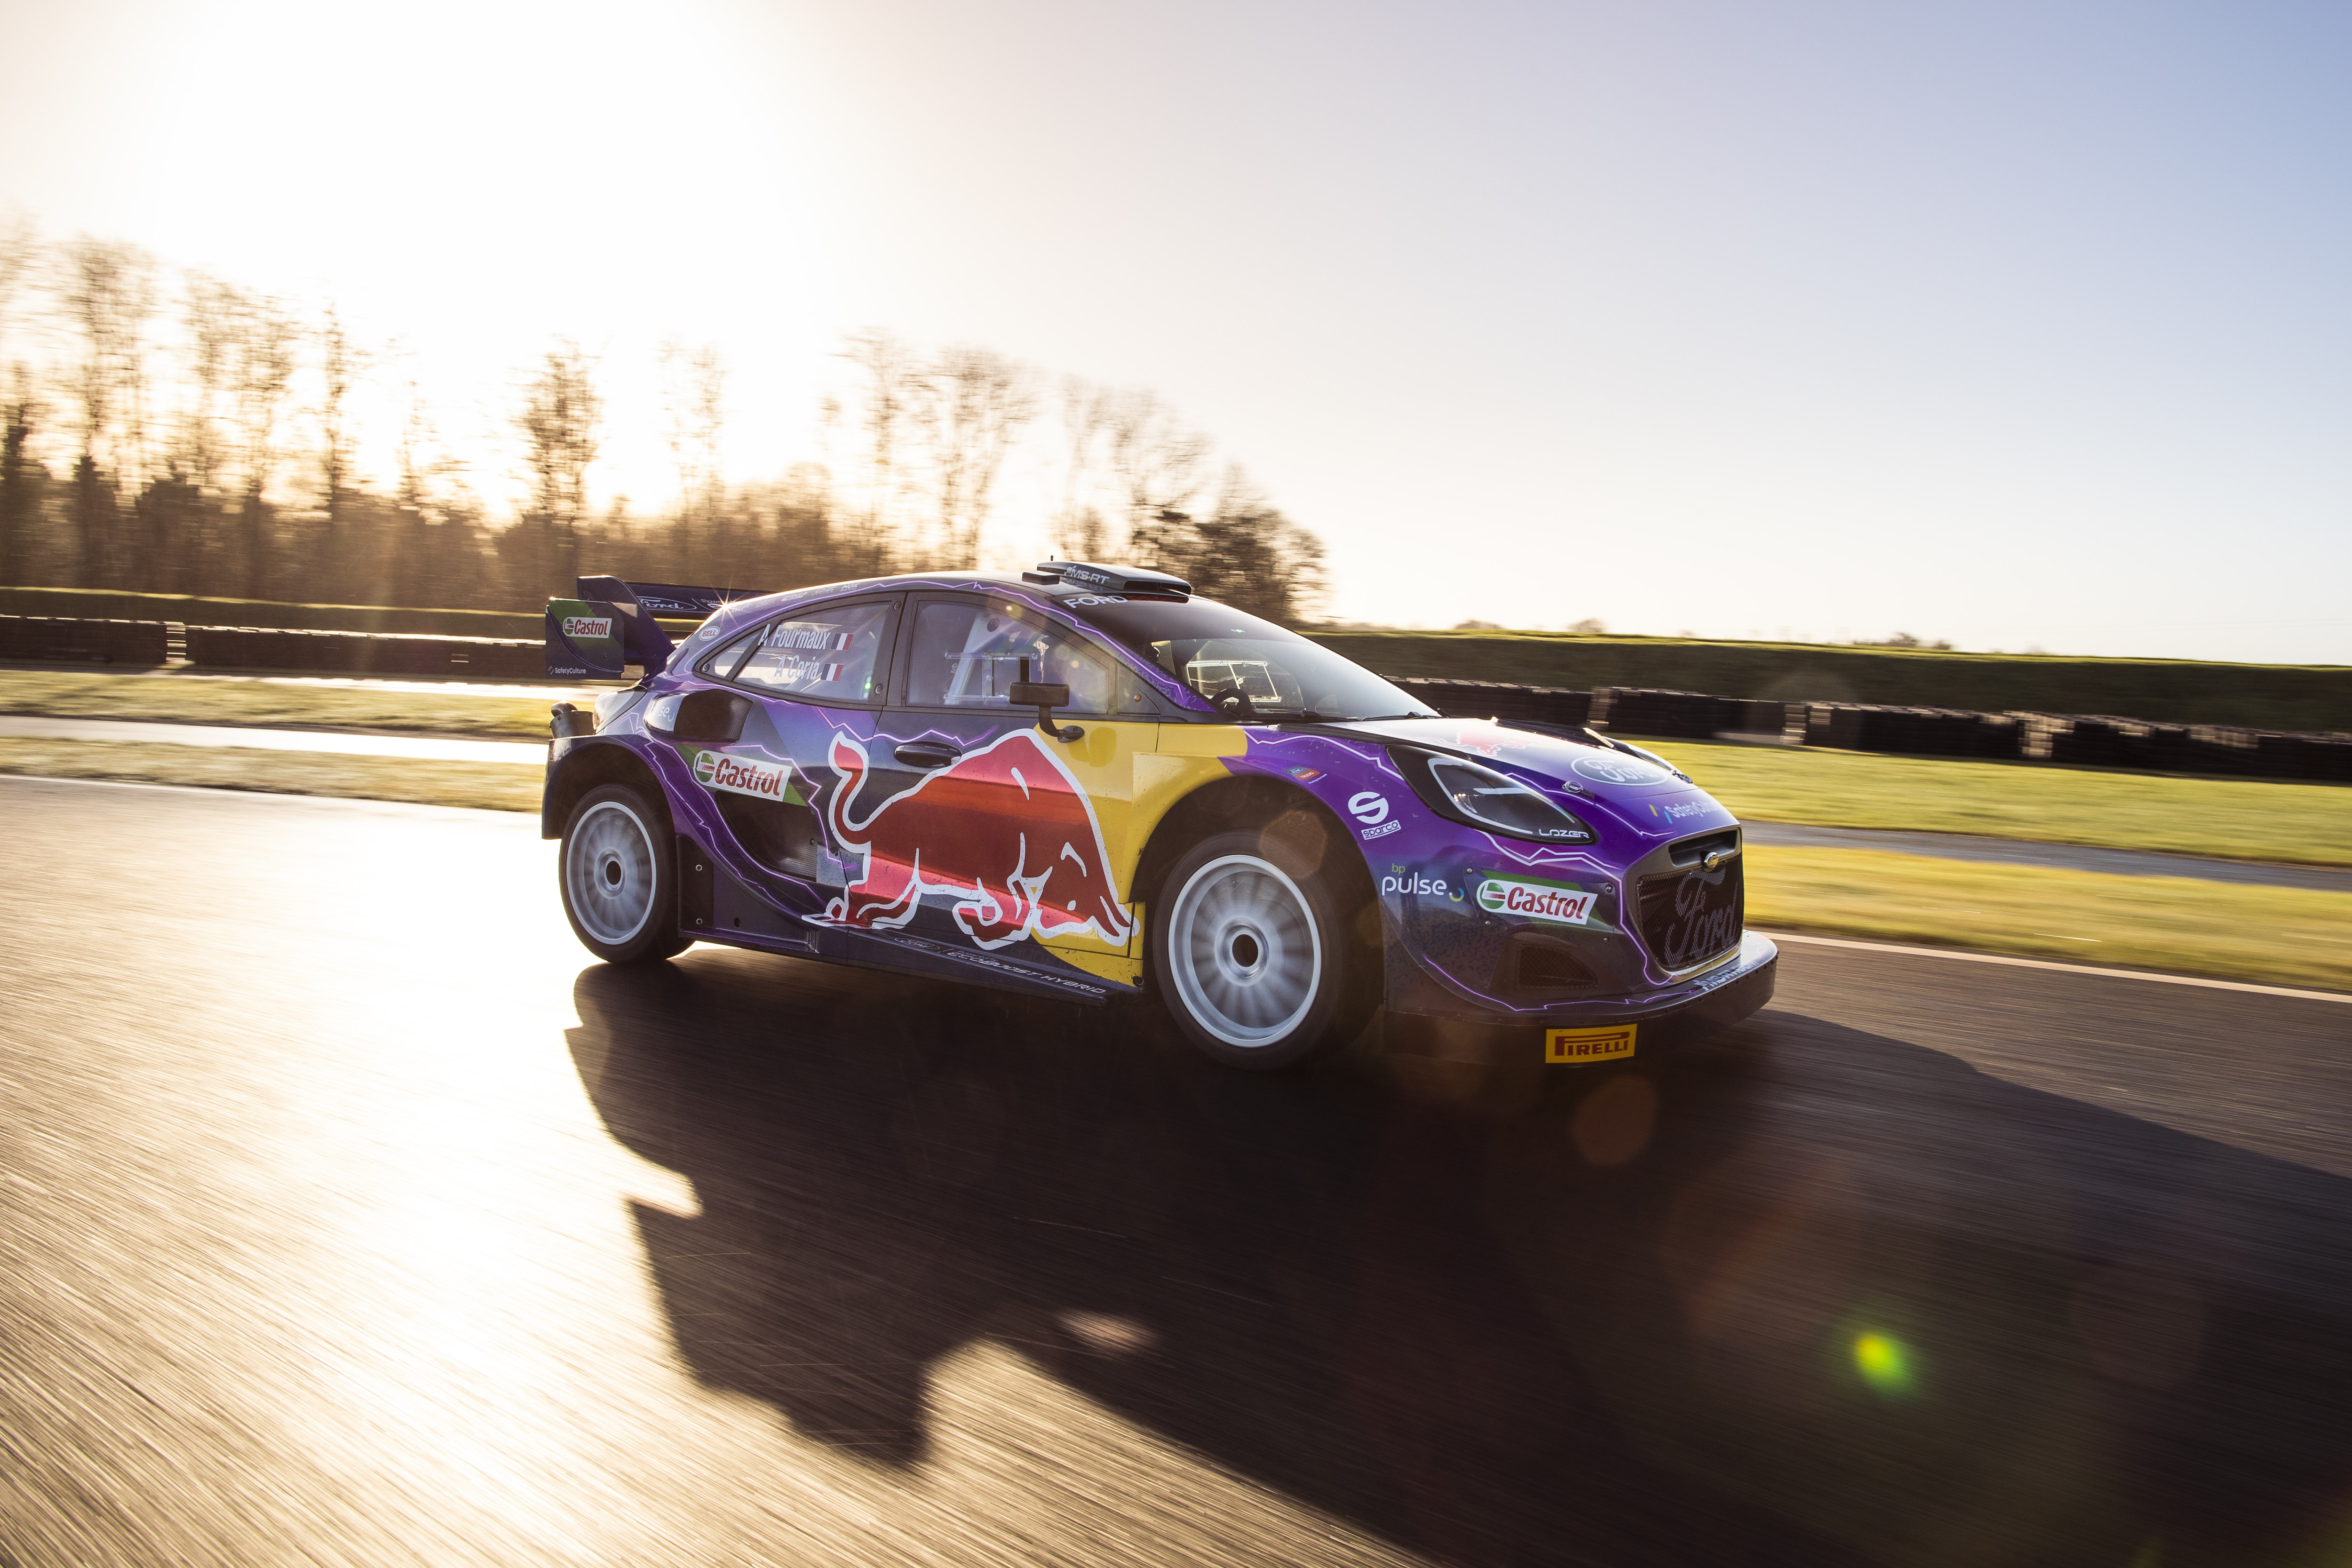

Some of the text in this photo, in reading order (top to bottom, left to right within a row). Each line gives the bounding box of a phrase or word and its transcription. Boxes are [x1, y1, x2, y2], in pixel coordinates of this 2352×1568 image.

[1063, 595, 1128, 609] FORD
[574, 619, 609, 636] Castrol
[757, 623, 831, 650] A Fourmaux
[774, 654, 820, 681] A Coria
[715, 758, 784, 796] Castrol
[1363, 821, 1398, 838] sparco
[1538, 828, 1589, 838] LAZER
[1391, 863, 1406, 875] bp
[1382, 872, 1447, 896] pulse
[1507, 886, 1589, 920] Castrol
[1040, 975, 1106, 994] HYBRID
[1554, 1031, 1630, 1056] PIRELLI
